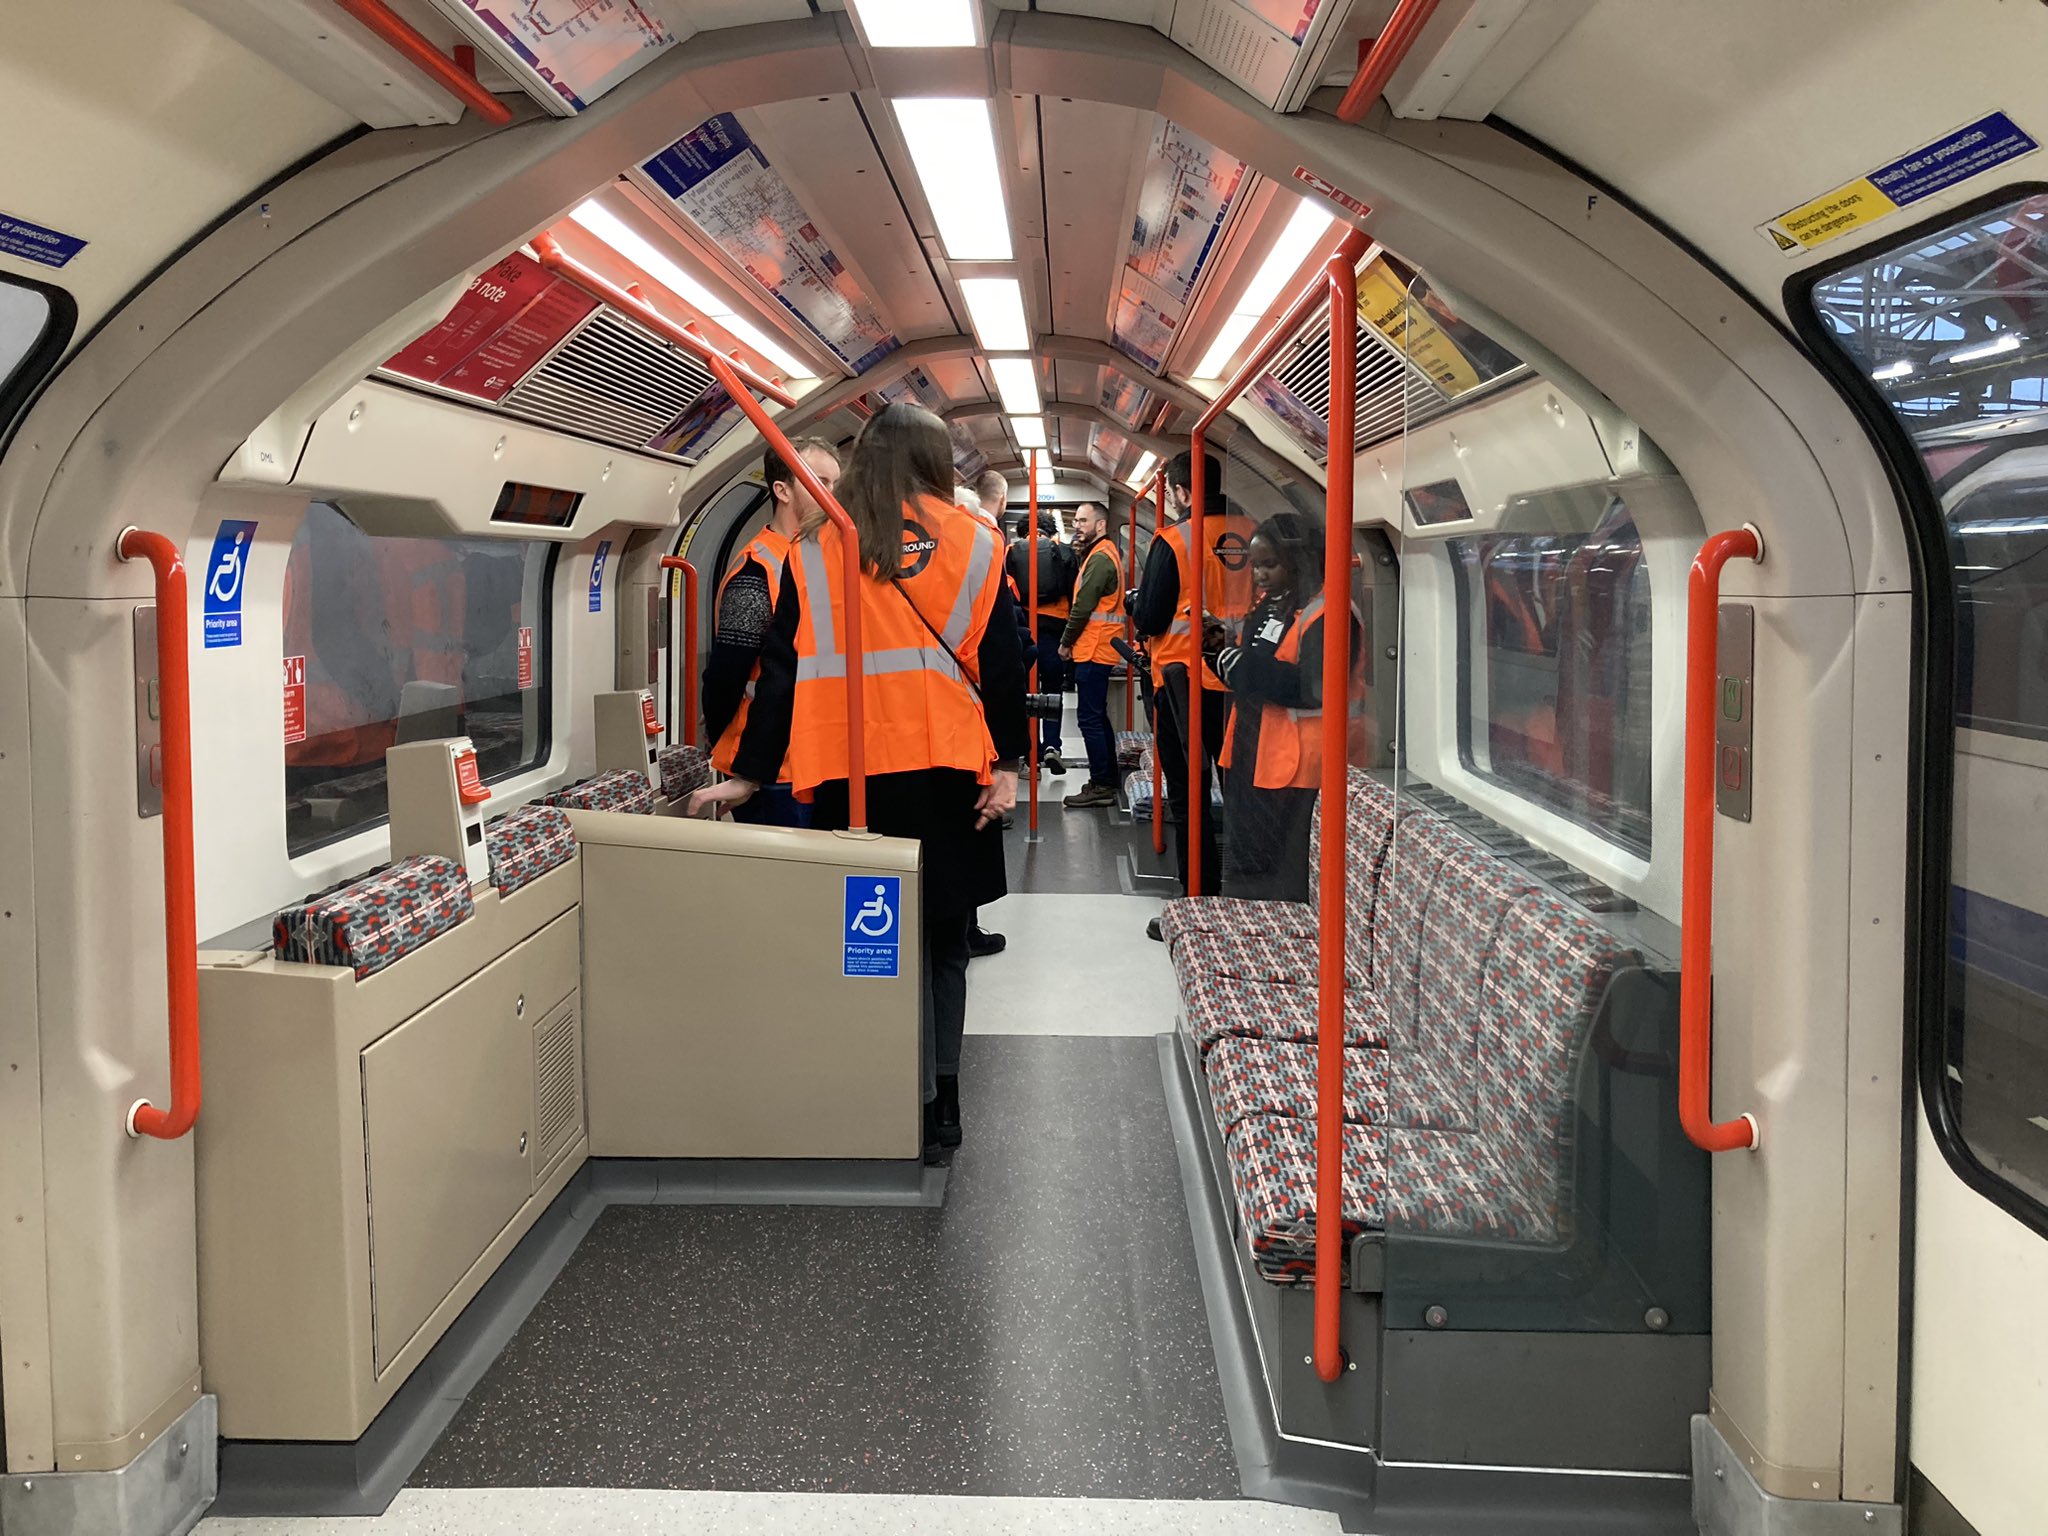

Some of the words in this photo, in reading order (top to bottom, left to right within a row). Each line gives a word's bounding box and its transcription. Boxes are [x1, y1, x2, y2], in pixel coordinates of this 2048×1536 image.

[1873, 168, 1908, 187] Penalty
[1903, 161, 1925, 173] fare
[1922, 155, 1935, 165] or
[1933, 131, 1987, 162] prosecution
[1588, 195, 1598, 211] F
[1786, 209, 1830, 231] Obstructing
[1825, 203, 1841, 214] the
[1839, 194, 1863, 208] doors
[1, 222, 13, 230] or
[9, 225, 61, 246] prosecution
[1799, 232, 1814, 241] can
[1809, 228, 1823, 236] be
[1821, 212, 1858, 232] dangerous
[494, 259, 522, 284] Make
[476, 282, 507, 303] note
[205, 618, 226, 630] Priority
[226, 619, 238, 628] area
[847, 946, 875, 956] Priority
